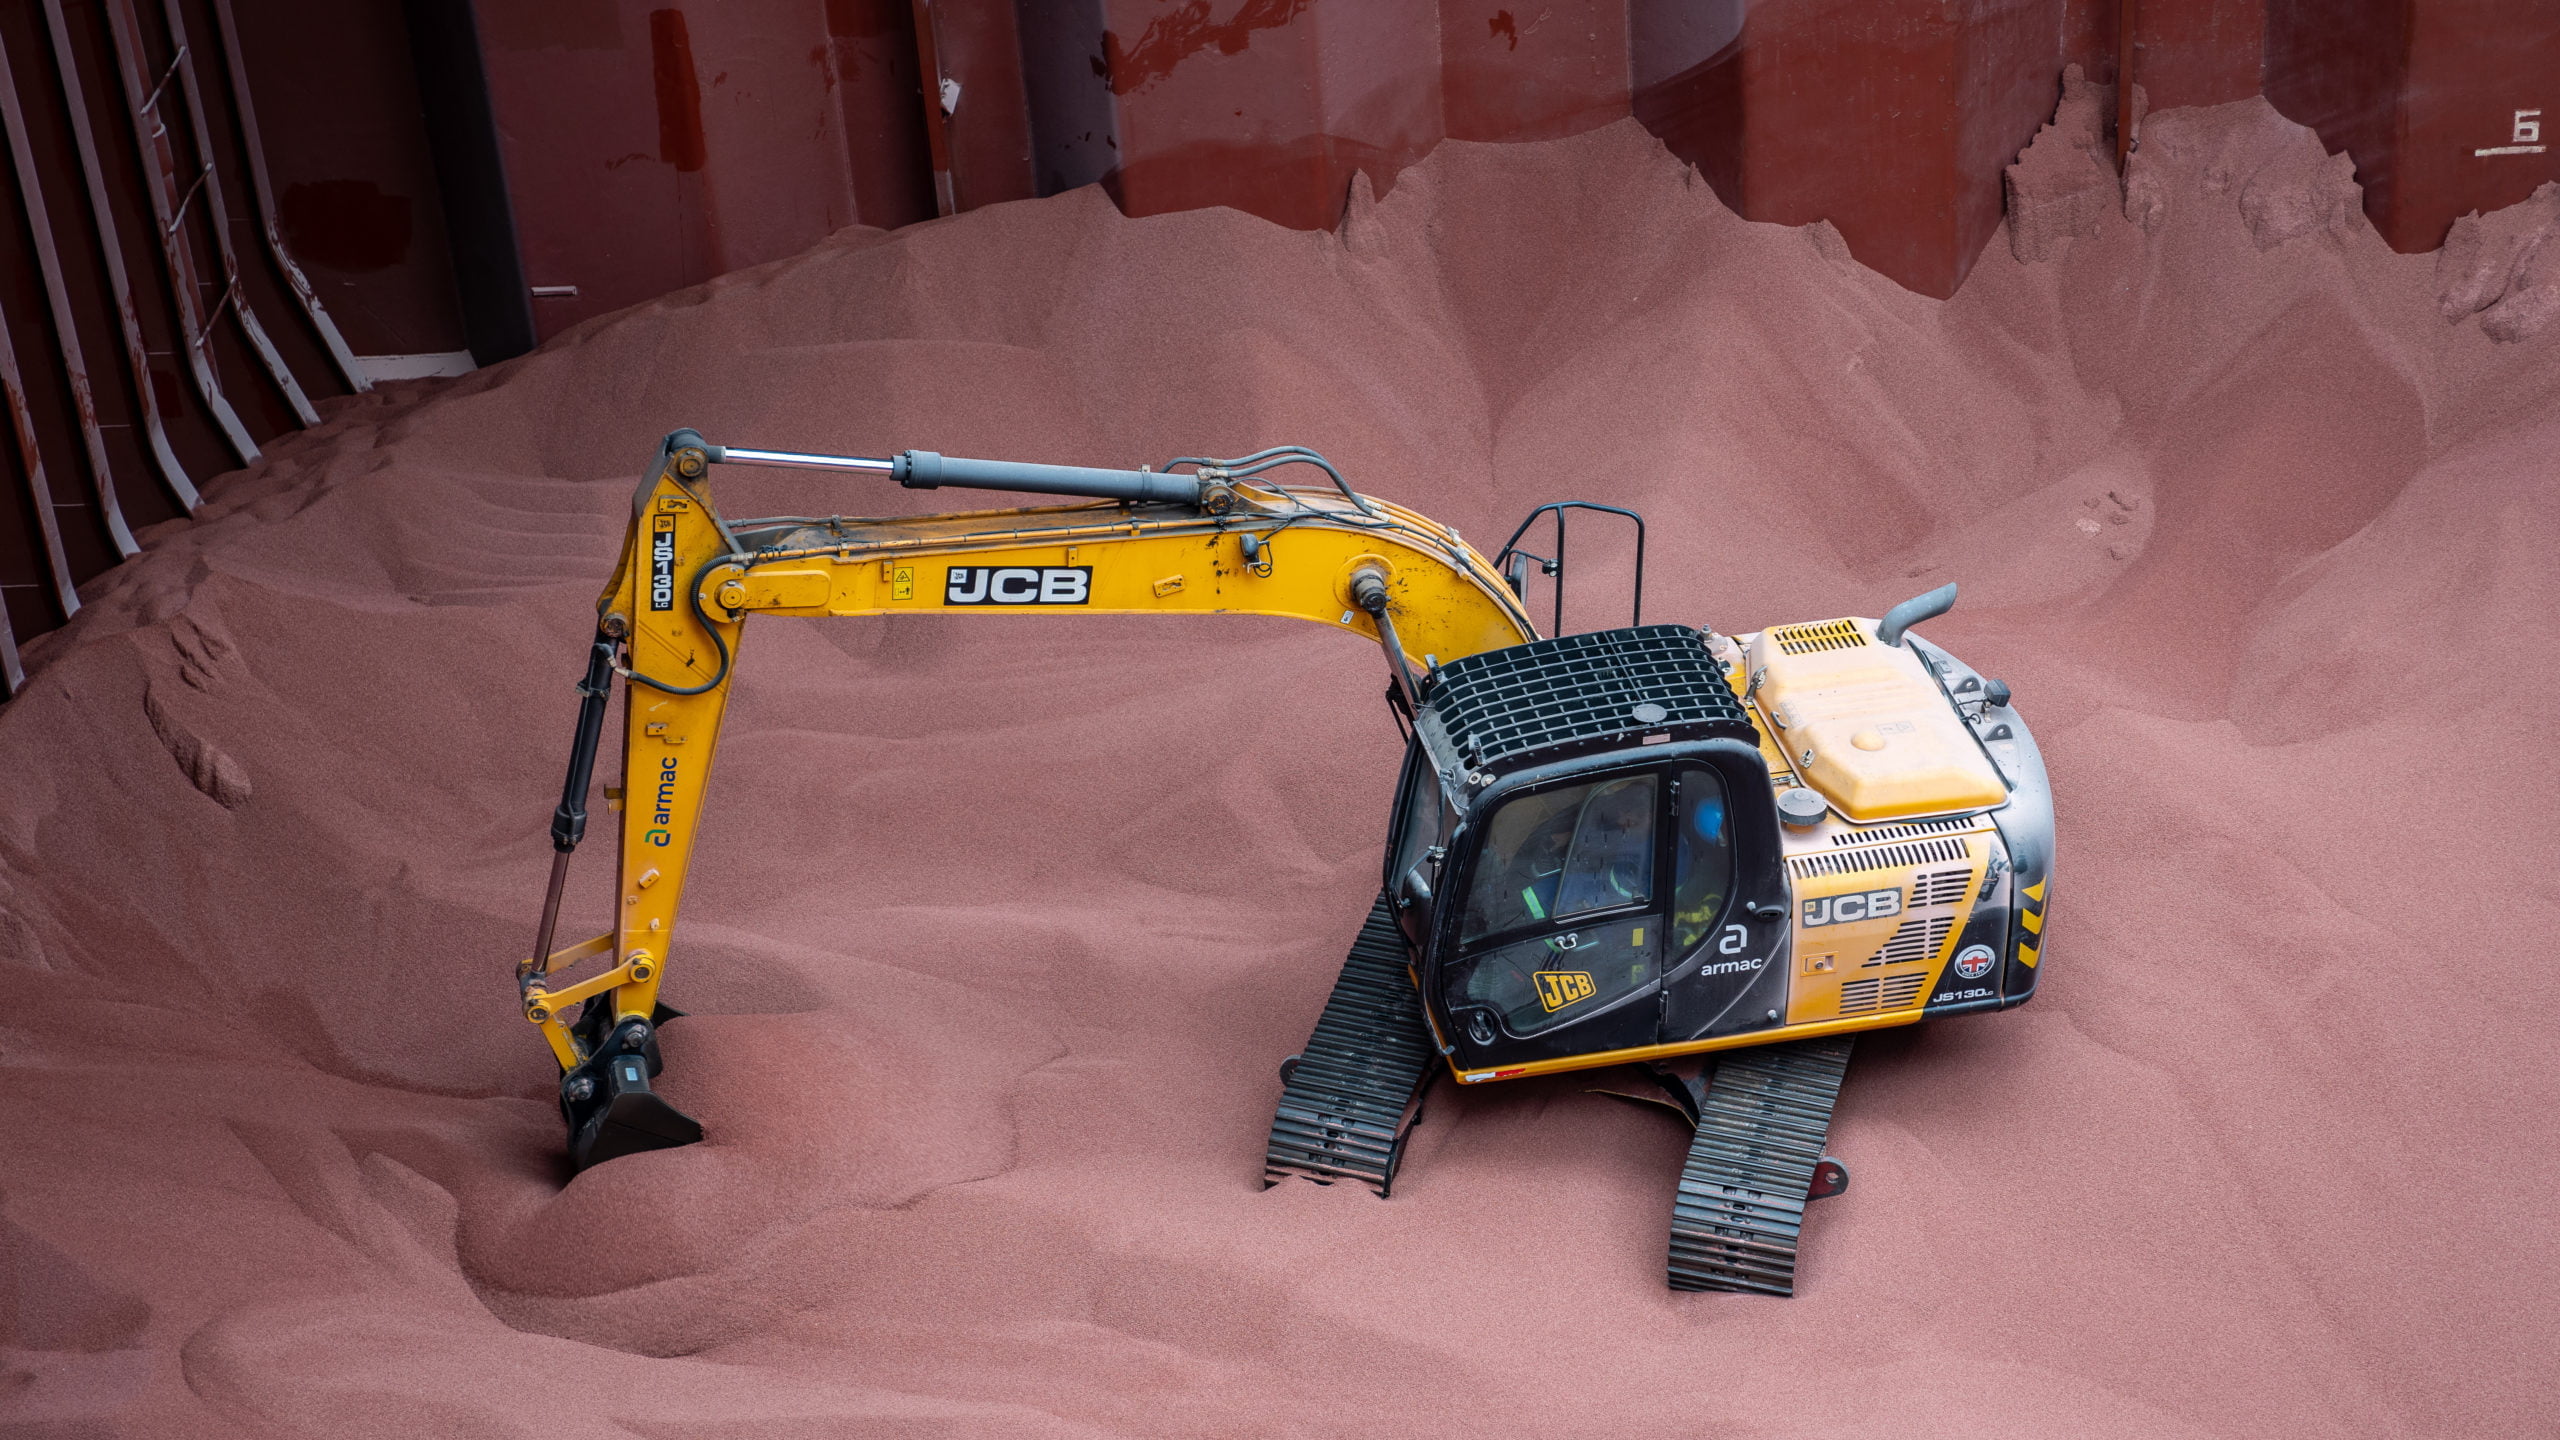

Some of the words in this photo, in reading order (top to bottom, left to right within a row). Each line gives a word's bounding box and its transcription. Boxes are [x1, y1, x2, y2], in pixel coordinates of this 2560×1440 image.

[2513, 110, 2541, 142] 6
[653, 533, 673, 602] JS130
[949, 569, 1087, 603] JCB
[654, 757, 677, 825] armac
[1804, 890, 1900, 926] JCB
[1701, 958, 1762, 976] armac
[1544, 974, 1592, 1008] JCB
